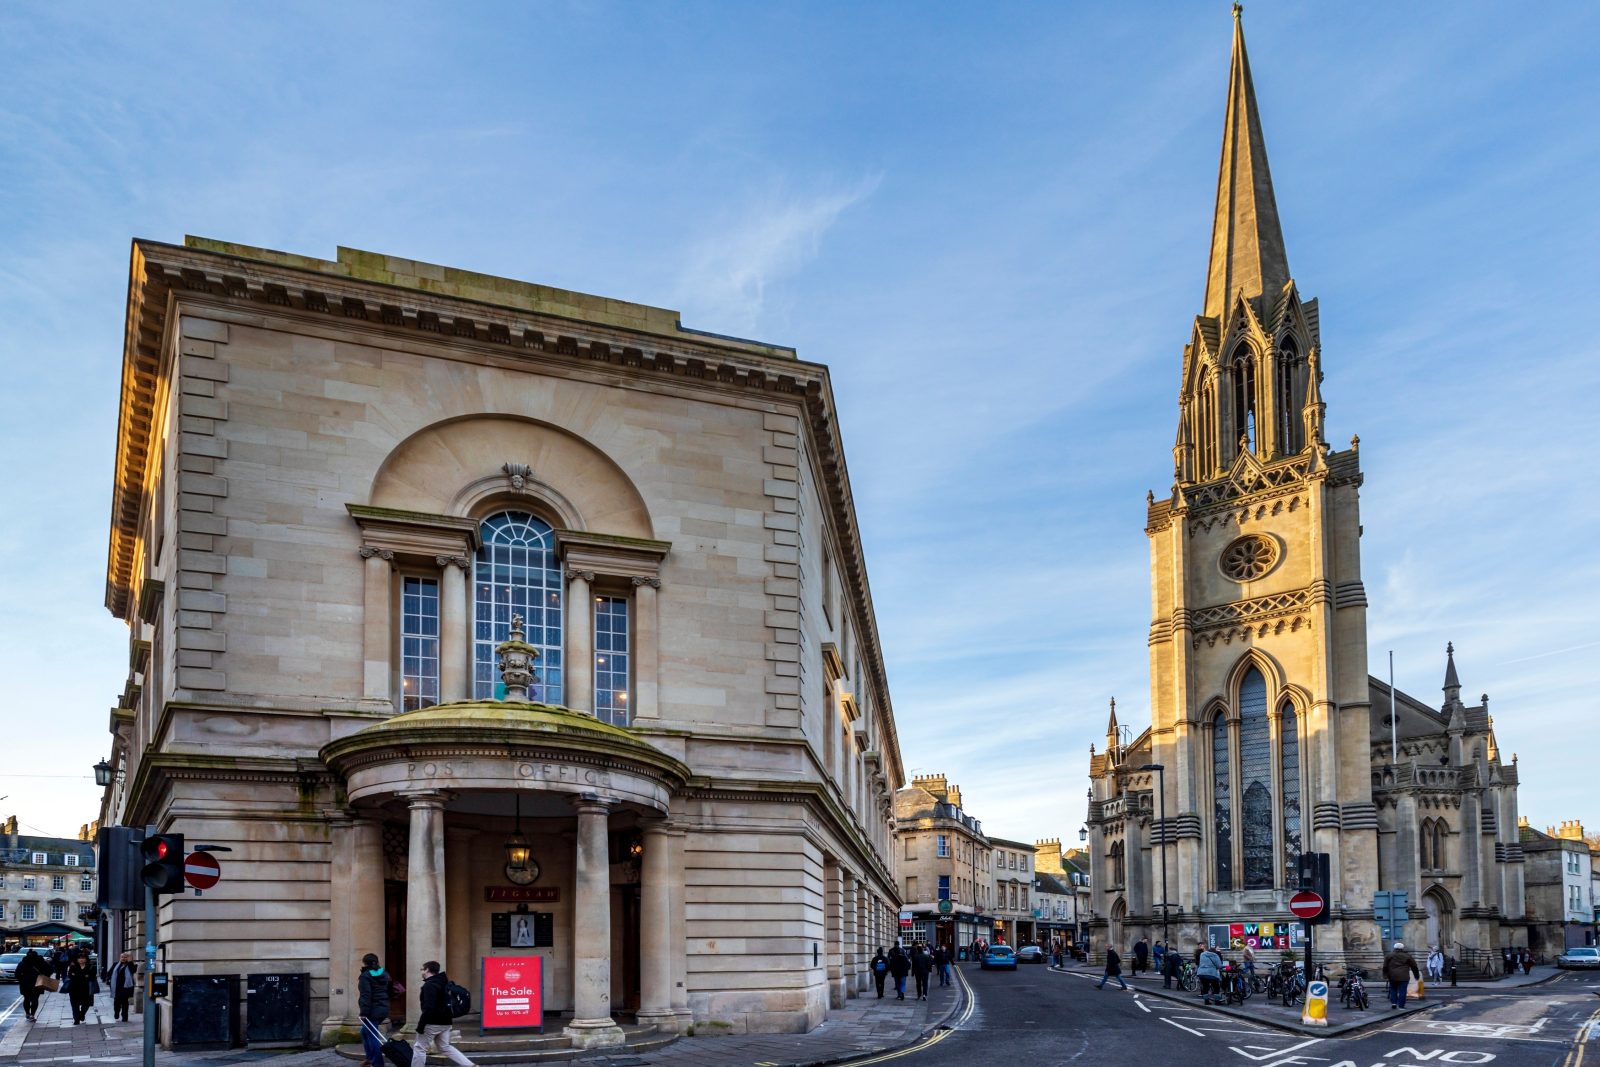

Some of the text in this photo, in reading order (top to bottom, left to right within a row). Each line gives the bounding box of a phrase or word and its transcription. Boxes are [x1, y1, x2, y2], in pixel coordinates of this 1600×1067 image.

[408, 762, 611, 786] POST OFFICE
[490, 889, 556, 898] JIGSAW
[490, 986, 535, 996] The Sale.
[1383, 1046, 1497, 1064] NO
